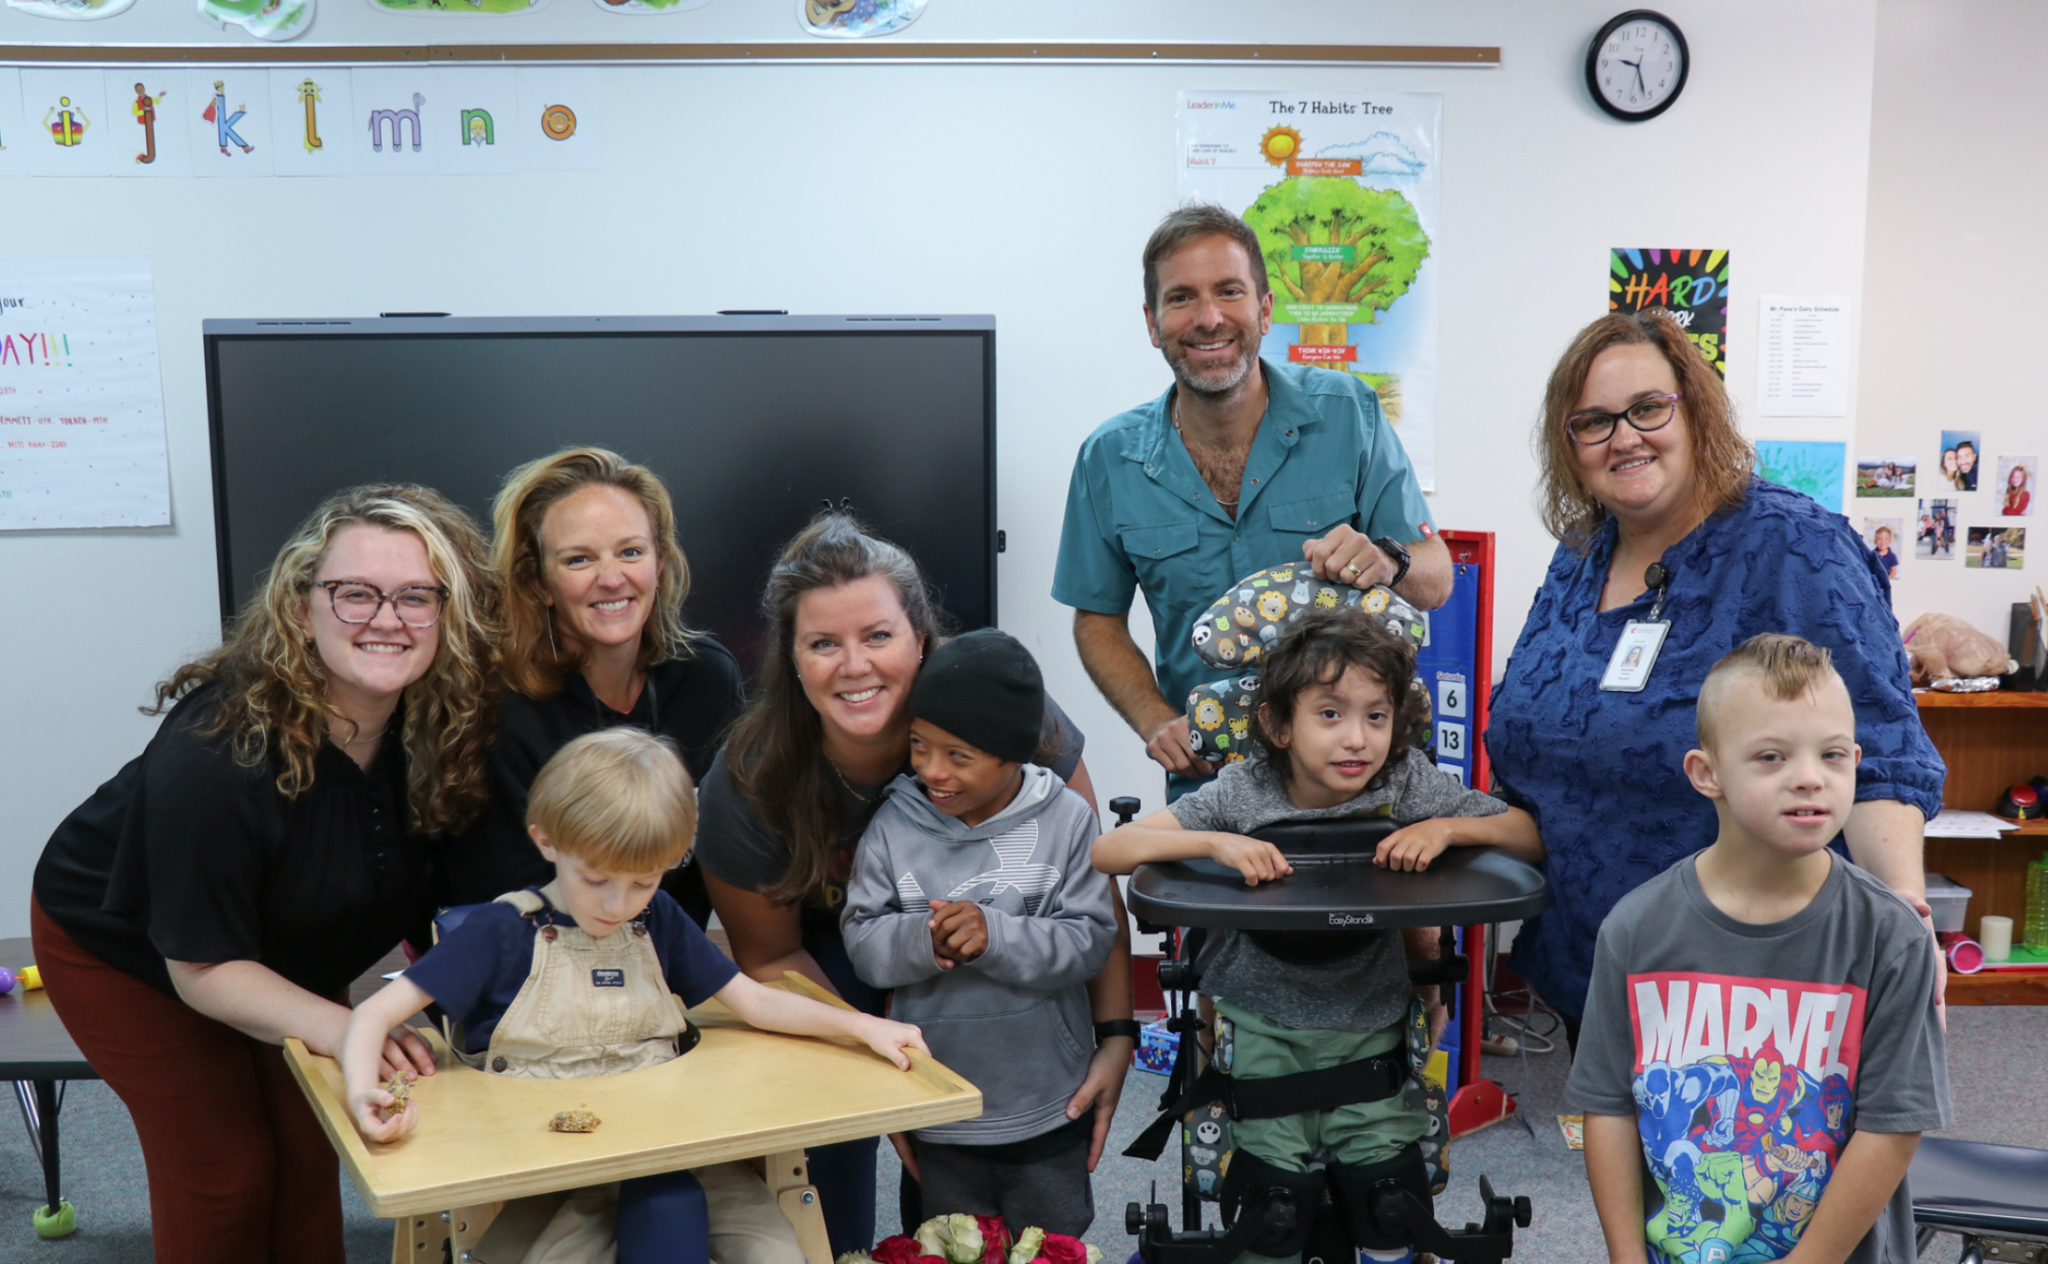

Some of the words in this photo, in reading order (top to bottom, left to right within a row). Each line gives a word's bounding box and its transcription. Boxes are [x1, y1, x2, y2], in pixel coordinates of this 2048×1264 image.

[1621, 30, 1630, 41] 11
[1635, 26, 1647, 37] 12
[1653, 31, 1658, 42] 1
[1608, 43, 1619, 53] 10
[1662, 43, 1670, 54] 2
[1601, 59, 1608, 69] 9
[1666, 61, 1673, 72] 3
[1604, 77, 1612, 87] 8
[1658, 79, 1665, 88] 4
[1616, 89, 1623, 100] 7
[1630, 94, 1637, 104] 6
[1647, 90, 1653, 100] 5
[1269, 101, 1295, 114] The
[1299, 101, 1308, 114] 7
[1362, 101, 1394, 114] Tree
[217, 94, 250, 147] k
[371, 108, 421, 150] m
[461, 108, 494, 145] n
[1624, 272, 1716, 311] HARD
[0, 332, 73, 367] AY!!!
[1446, 690, 1458, 708] 6
[1442, 729, 1460, 750] 13
[1634, 980, 1853, 1083] MARVEL
